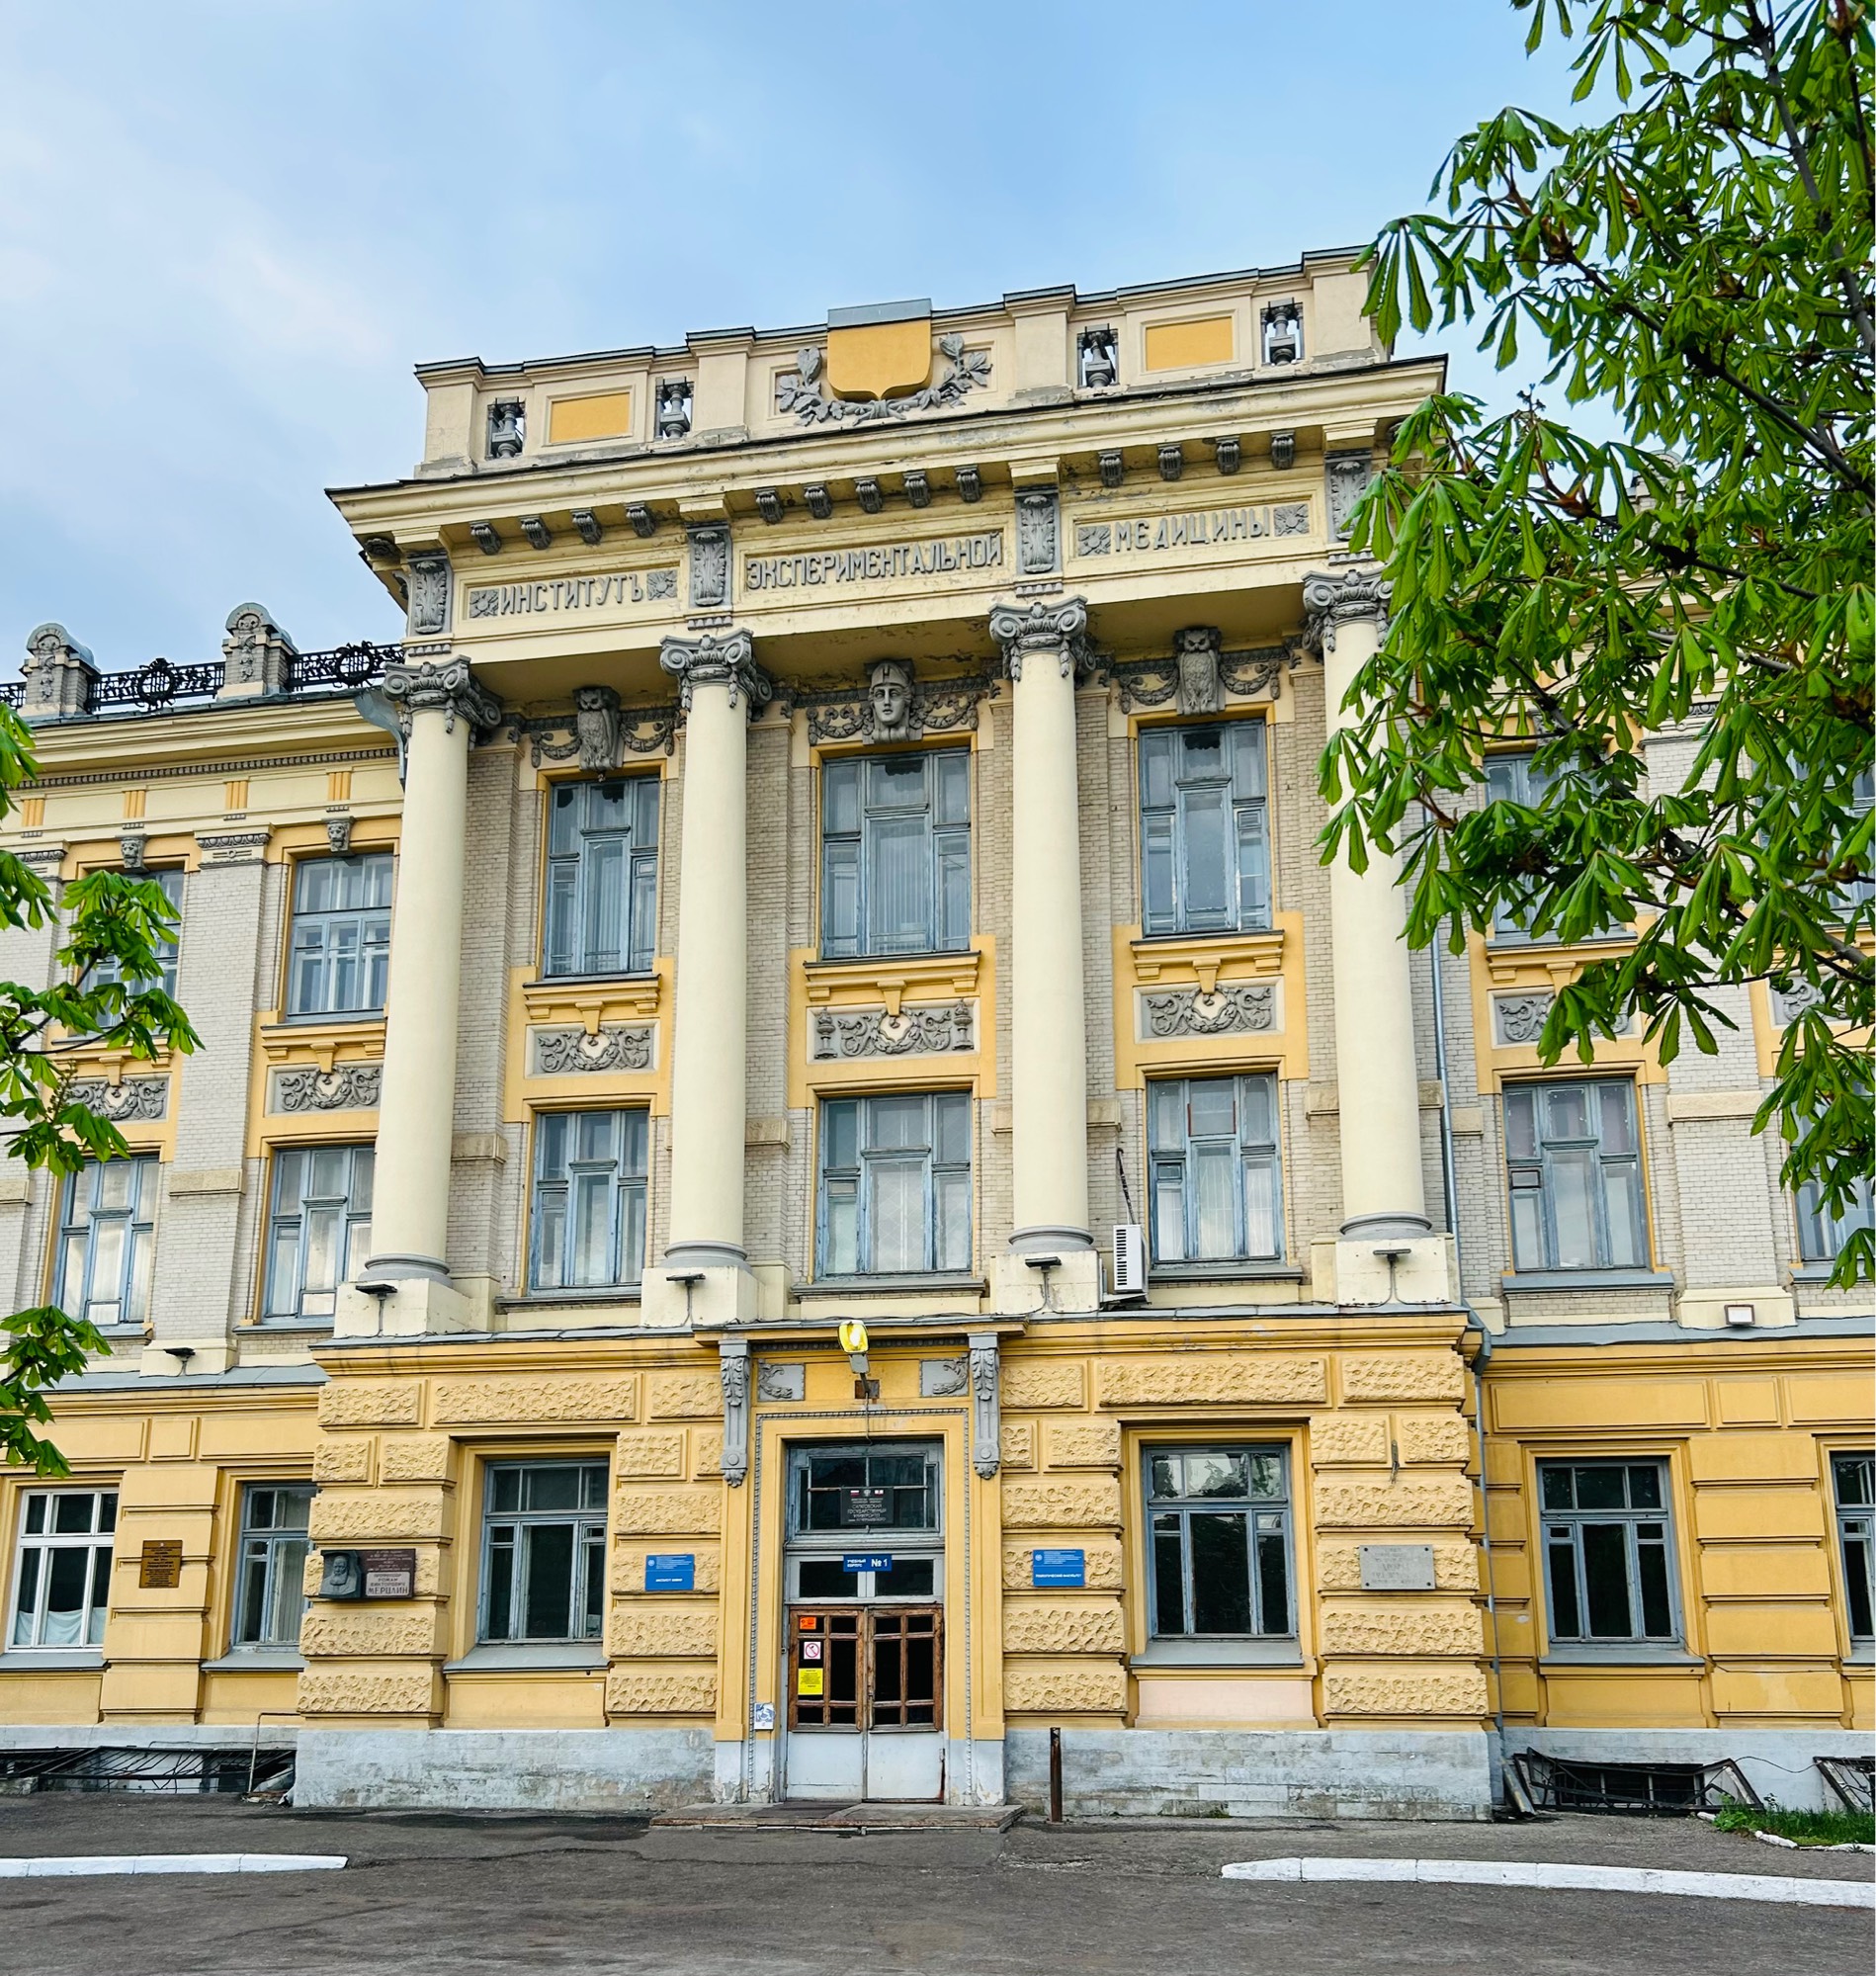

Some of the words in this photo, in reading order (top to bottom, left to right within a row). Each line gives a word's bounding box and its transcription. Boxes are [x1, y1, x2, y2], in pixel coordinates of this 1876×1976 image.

[500, 573, 643, 615] ИНСТИТУТЪ
[746, 531, 1003, 590] ЭКСПЕРИМЕНТАЛЬНОЙ
[1115, 506, 1270, 552] МЕДИЦИНЫ
